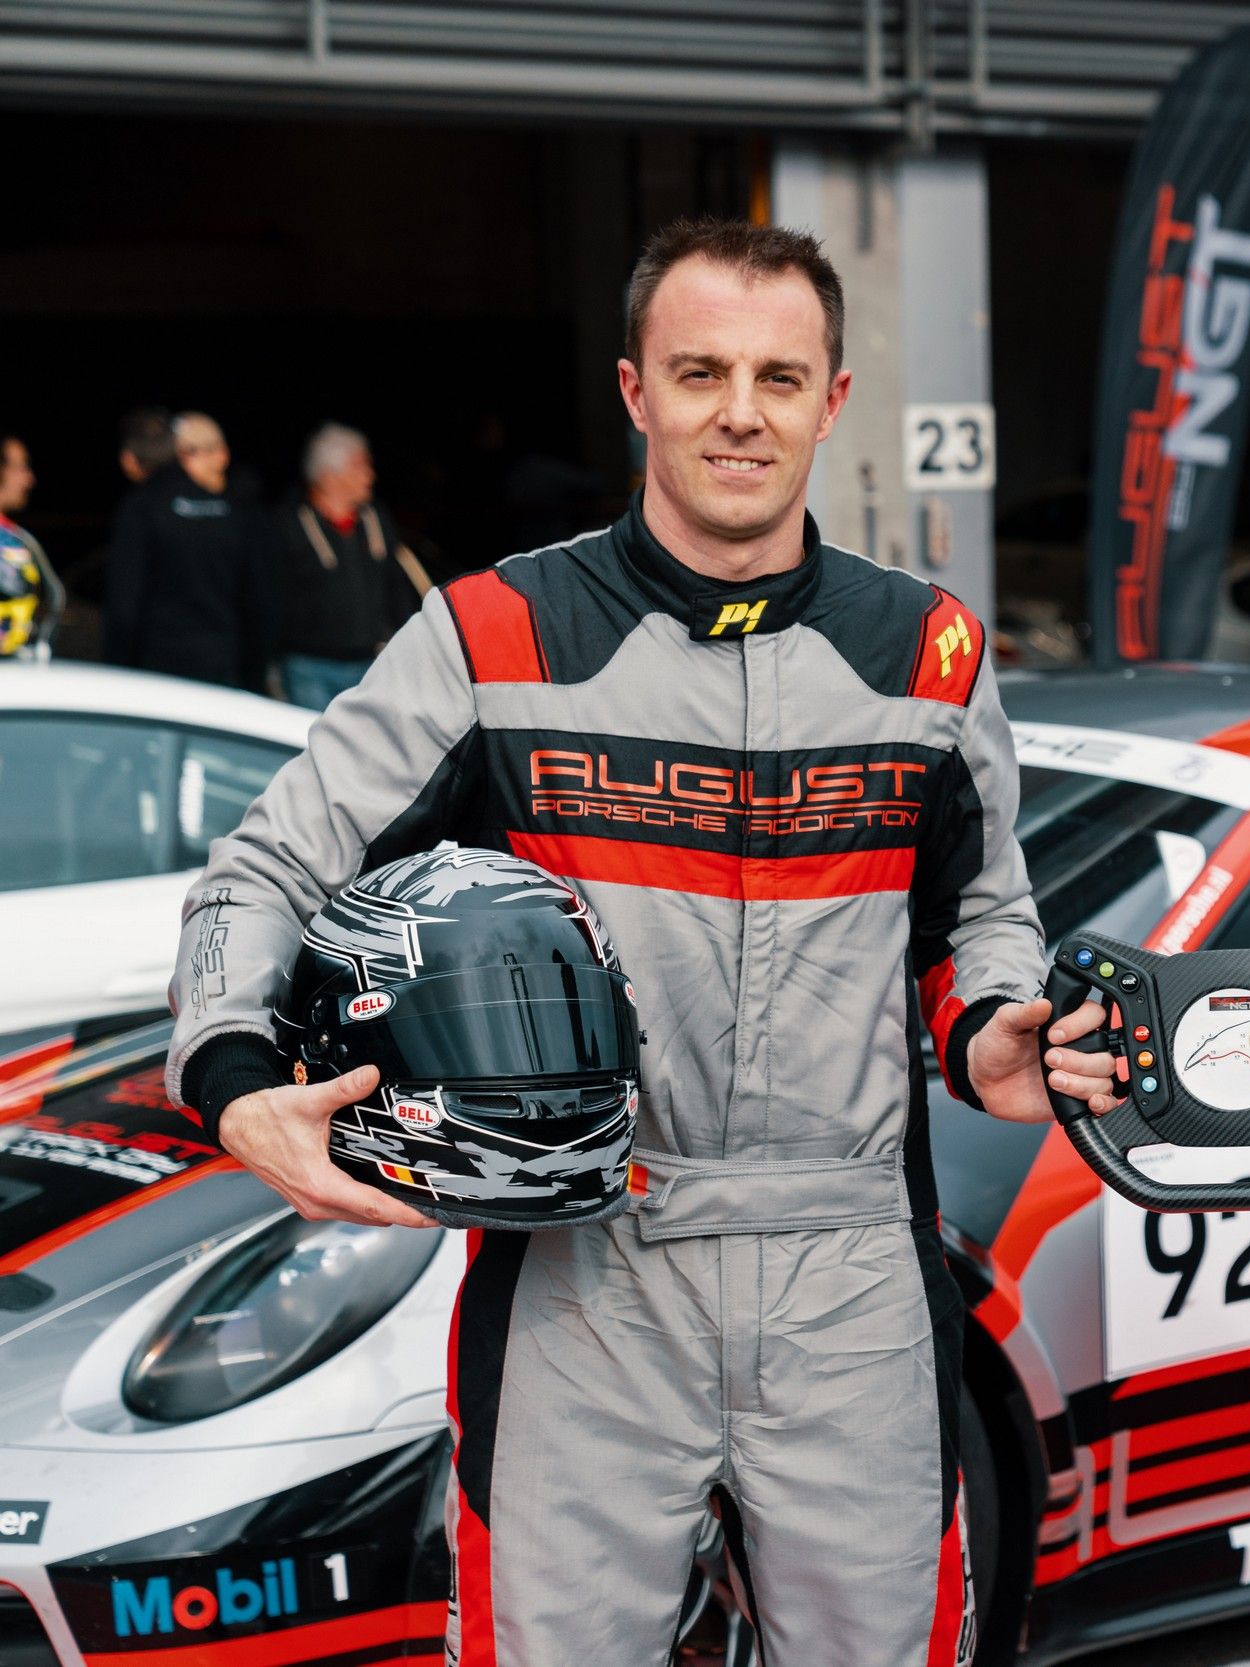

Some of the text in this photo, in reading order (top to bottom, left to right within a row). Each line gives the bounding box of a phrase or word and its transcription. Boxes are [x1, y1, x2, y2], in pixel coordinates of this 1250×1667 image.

[917, 419, 983, 473] 23
[529, 749, 927, 807] AUGUST
[532, 799, 920, 836] PORSCHE ADDICTION
[353, 996, 385, 1014] BELL
[398, 1104, 434, 1123] BELL
[402, 1119, 430, 1127] HELMETS
[111, 1552, 349, 1638] Mobil 1
